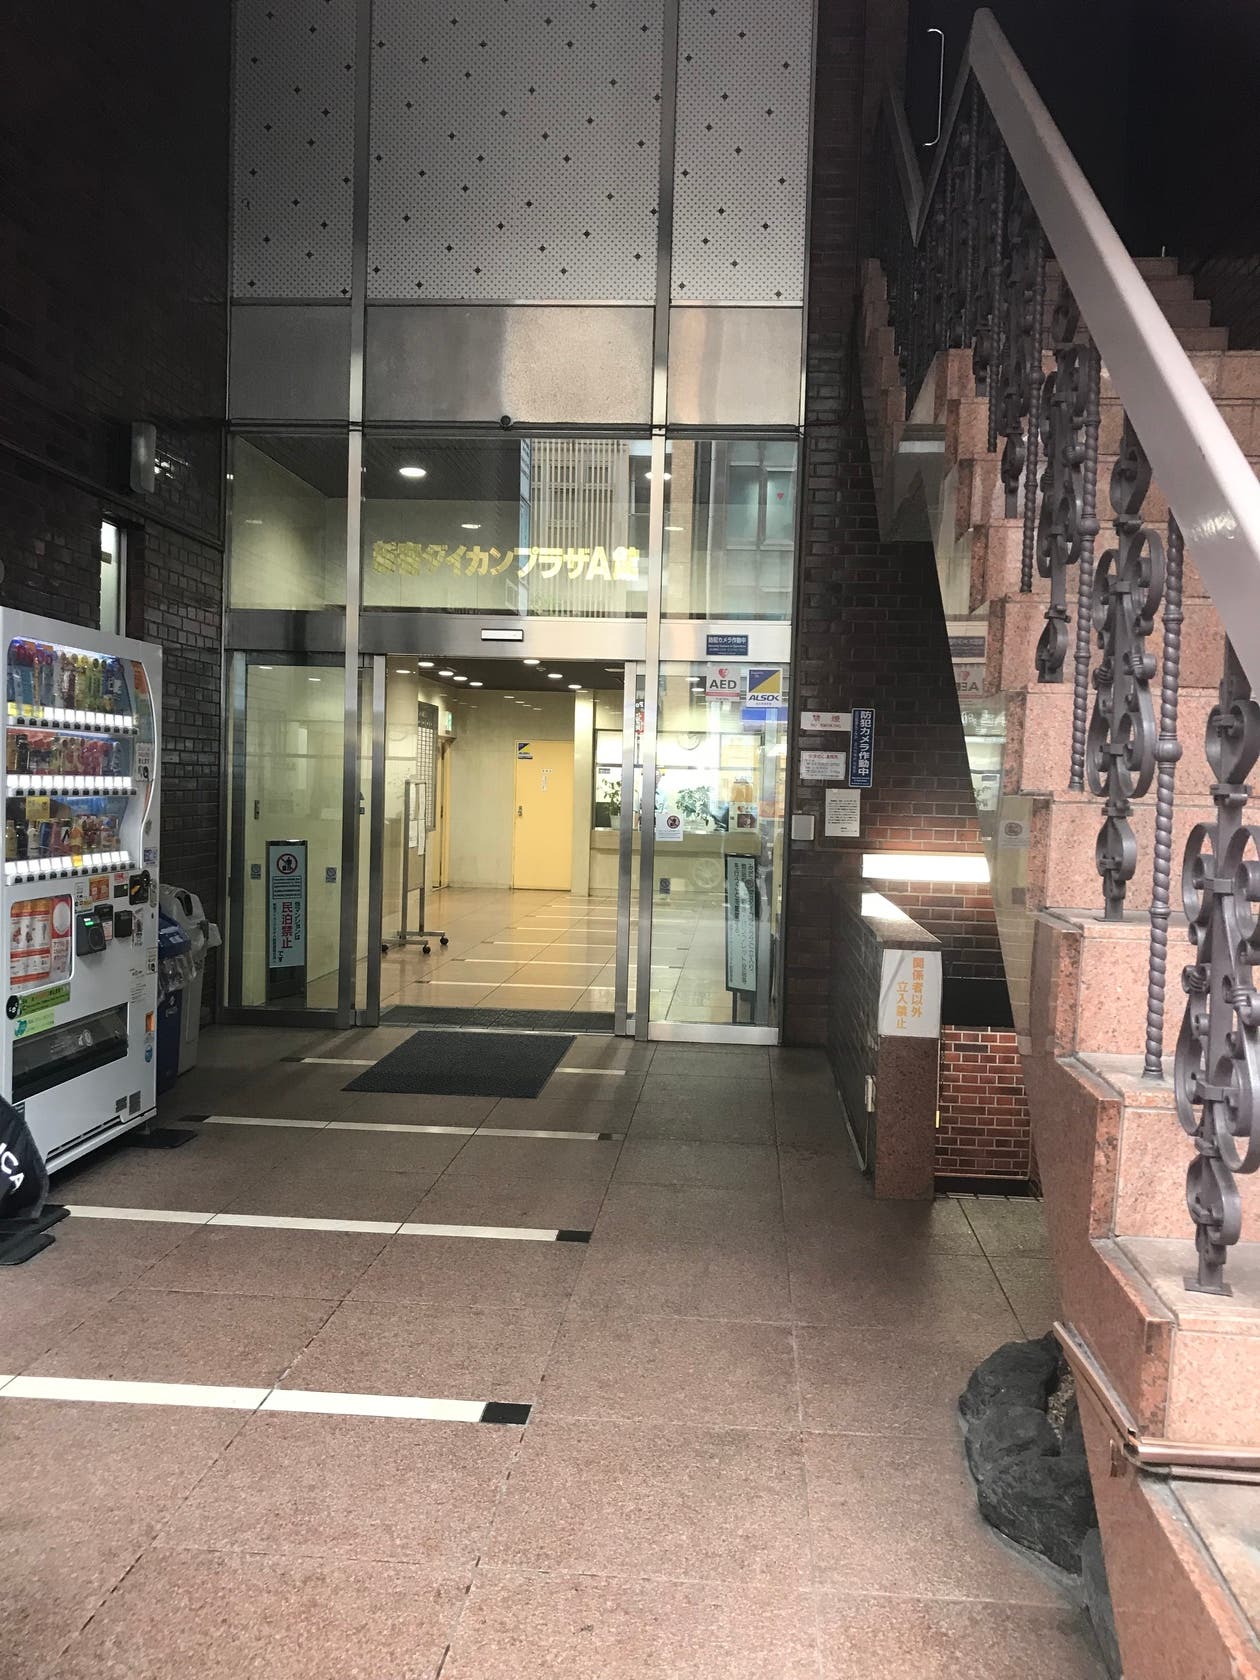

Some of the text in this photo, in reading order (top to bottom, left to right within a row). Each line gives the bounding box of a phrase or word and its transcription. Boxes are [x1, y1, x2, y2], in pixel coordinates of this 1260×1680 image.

[709, 679, 737, 690] AED
[748, 694, 780, 702] ALSOK
[858, 710, 872, 776] 防犯カメラ作動中
[281, 901, 293, 949] 民泊禁止
[896, 981, 909, 1030] 立入禁止
[911, 957, 925, 1018] 関係者以外
